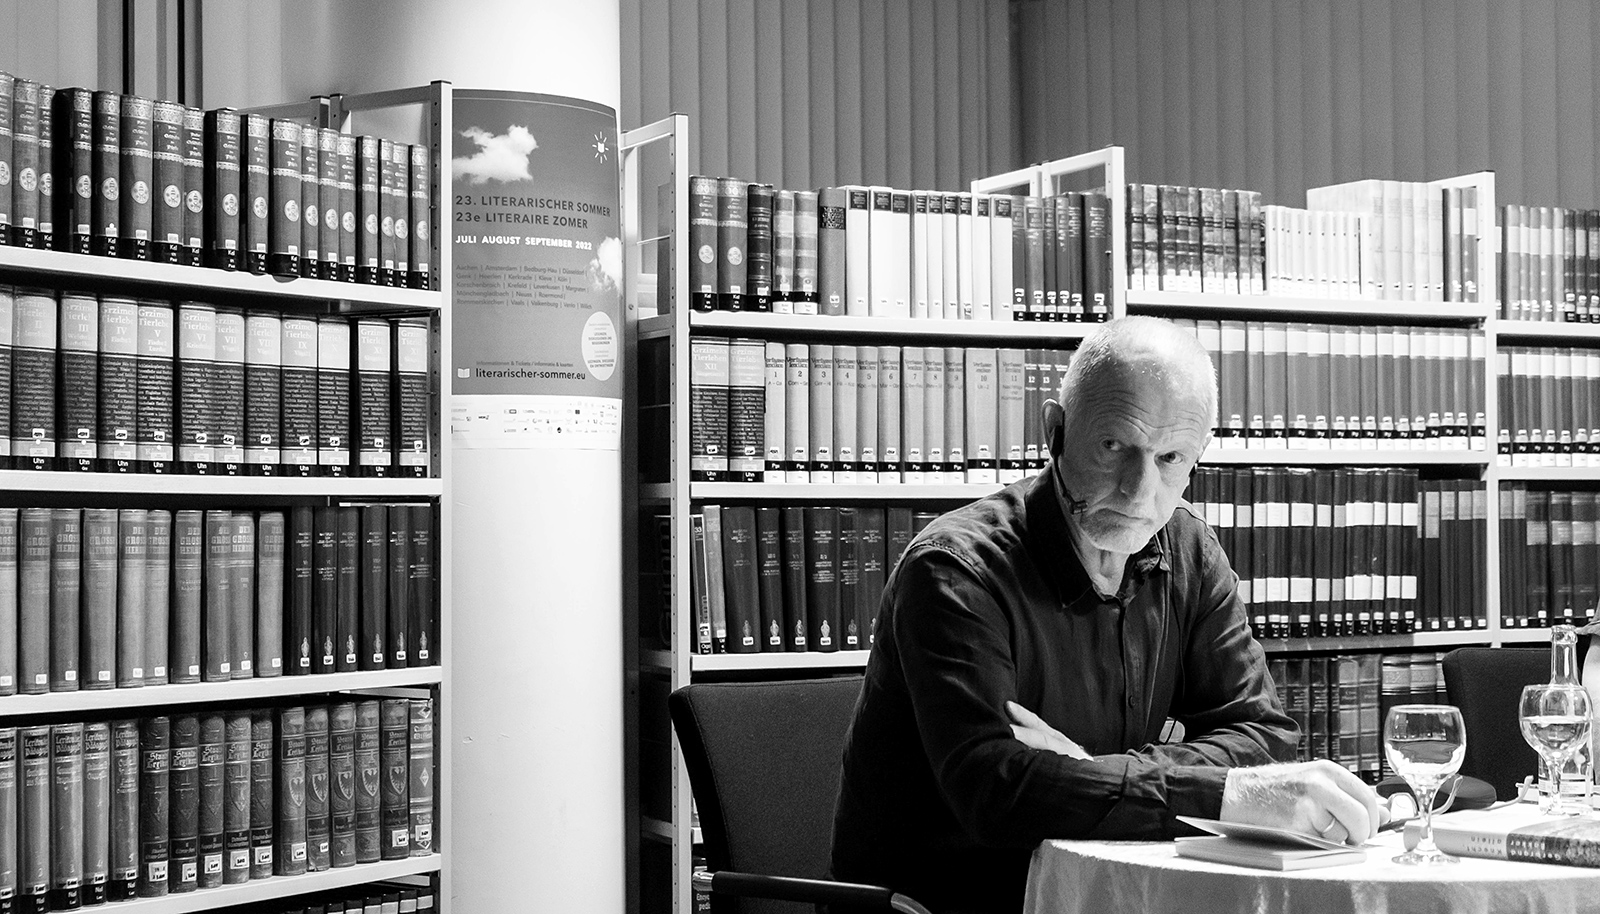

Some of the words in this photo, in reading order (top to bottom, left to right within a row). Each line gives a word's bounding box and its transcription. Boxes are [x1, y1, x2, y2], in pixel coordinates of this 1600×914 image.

[456, 196, 477, 206] 23.
[482, 196, 574, 211] LITERARISCHER
[577, 202, 611, 217] SOMMER
[456, 212, 481, 223] 23e
[486, 213, 549, 225] LITERAIRE
[553, 216, 588, 229] ZOMER
[456, 236, 477, 244] JULI
[482, 236, 521, 245] AUGUST
[525, 237, 572, 248] SEPTEMBER
[576, 241, 592, 250] 2022
[78, 324, 89, 332] III
[117, 326, 128, 335] IV
[154, 330, 161, 338] V
[196, 333, 206, 342] VI
[692, 346, 728, 354] Grzimeks
[693, 354, 727, 362] Tierleben
[704, 363, 717, 371] XII
[476, 368, 586, 380] literarischer-sommer.eu
[798, 370, 803, 378] 2
[1042, 376, 1050, 384] 13
[1510, 850, 1562, 861] Gerbrand
